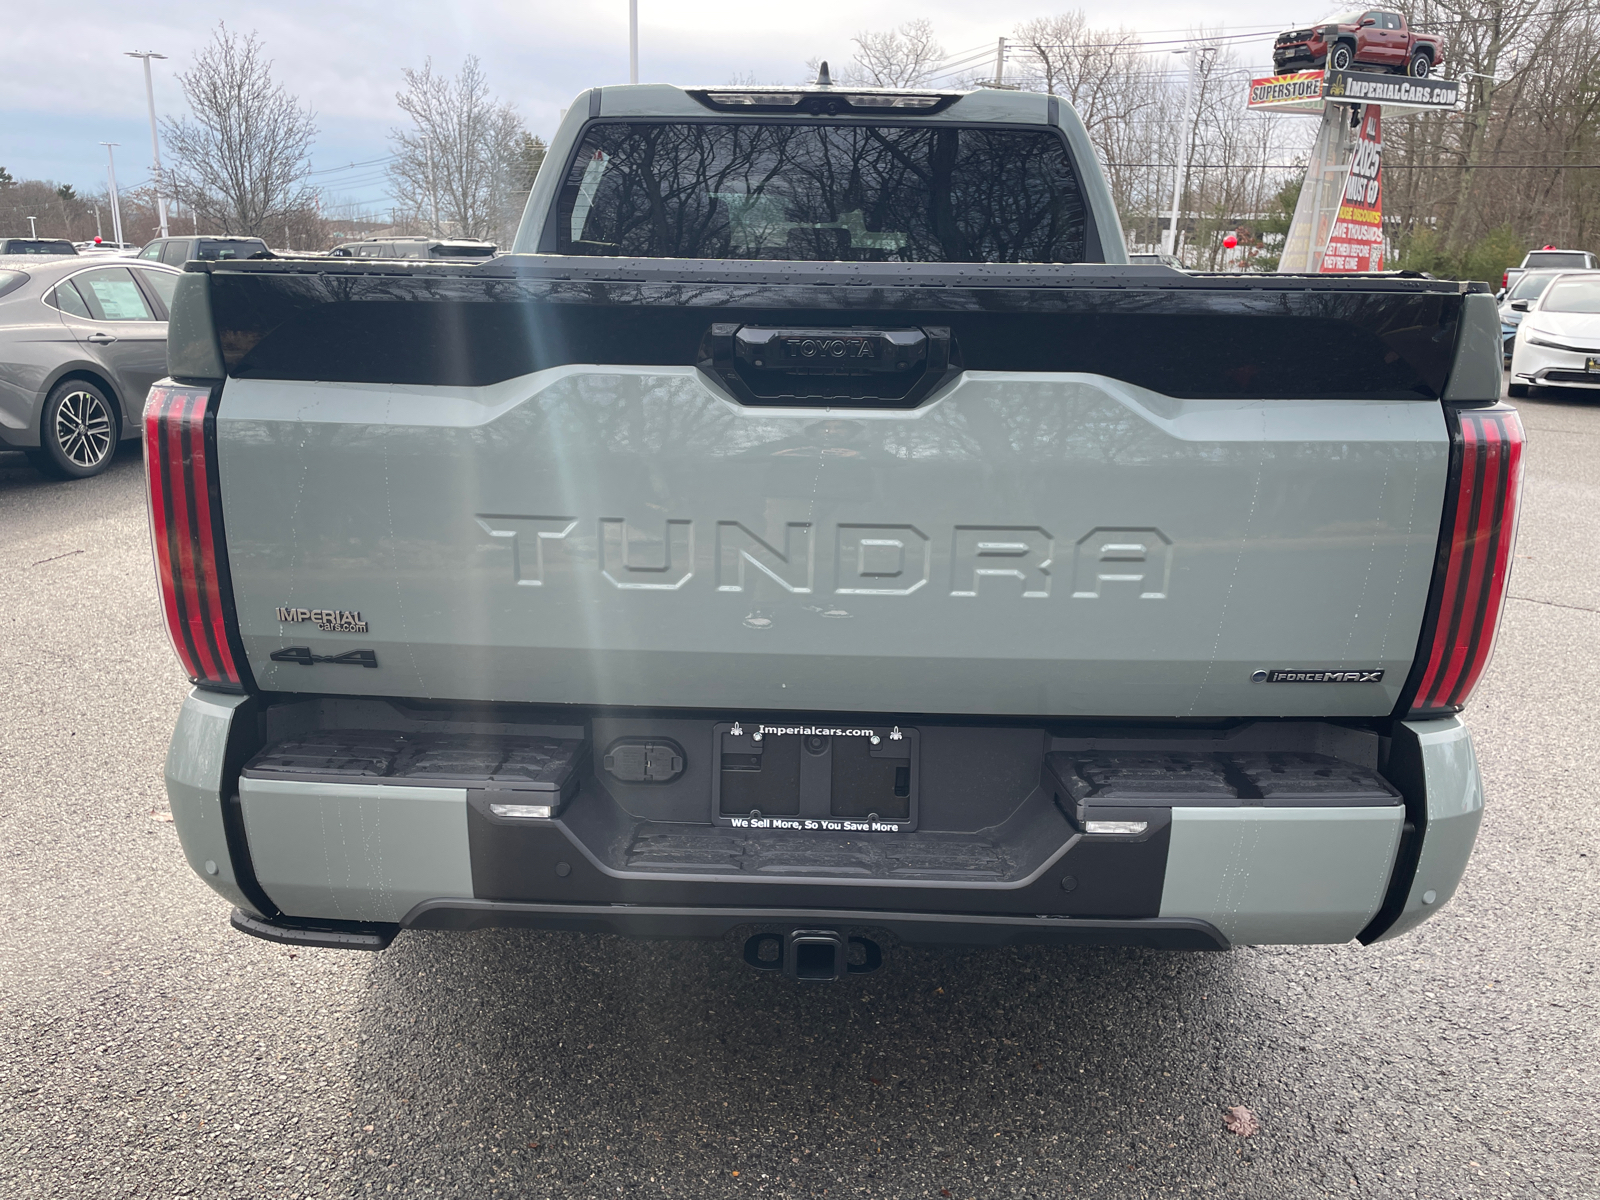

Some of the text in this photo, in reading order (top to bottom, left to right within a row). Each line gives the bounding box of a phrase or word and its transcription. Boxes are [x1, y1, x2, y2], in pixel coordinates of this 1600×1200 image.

[1251, 79, 1320, 102] SUPERSTORE
[1366, 116, 1377, 136] ALL
[1352, 137, 1382, 178] 2025
[1345, 175, 1368, 202] MUST
[1367, 179, 1379, 205] GO
[1353, 208, 1381, 224] DISCOUNTS
[1347, 224, 1382, 242] THOUSANDS
[1350, 244, 1370, 257] BEFORE
[787, 339, 875, 358] TOYOTA
[475, 513, 1174, 600] TUNDRA
[275, 607, 366, 626] IMPERIAL
[317, 622, 368, 633] cars.com
[759, 724, 874, 737] Imperialcars.com
[731, 819, 899, 832] We Sell More, So You Save More
